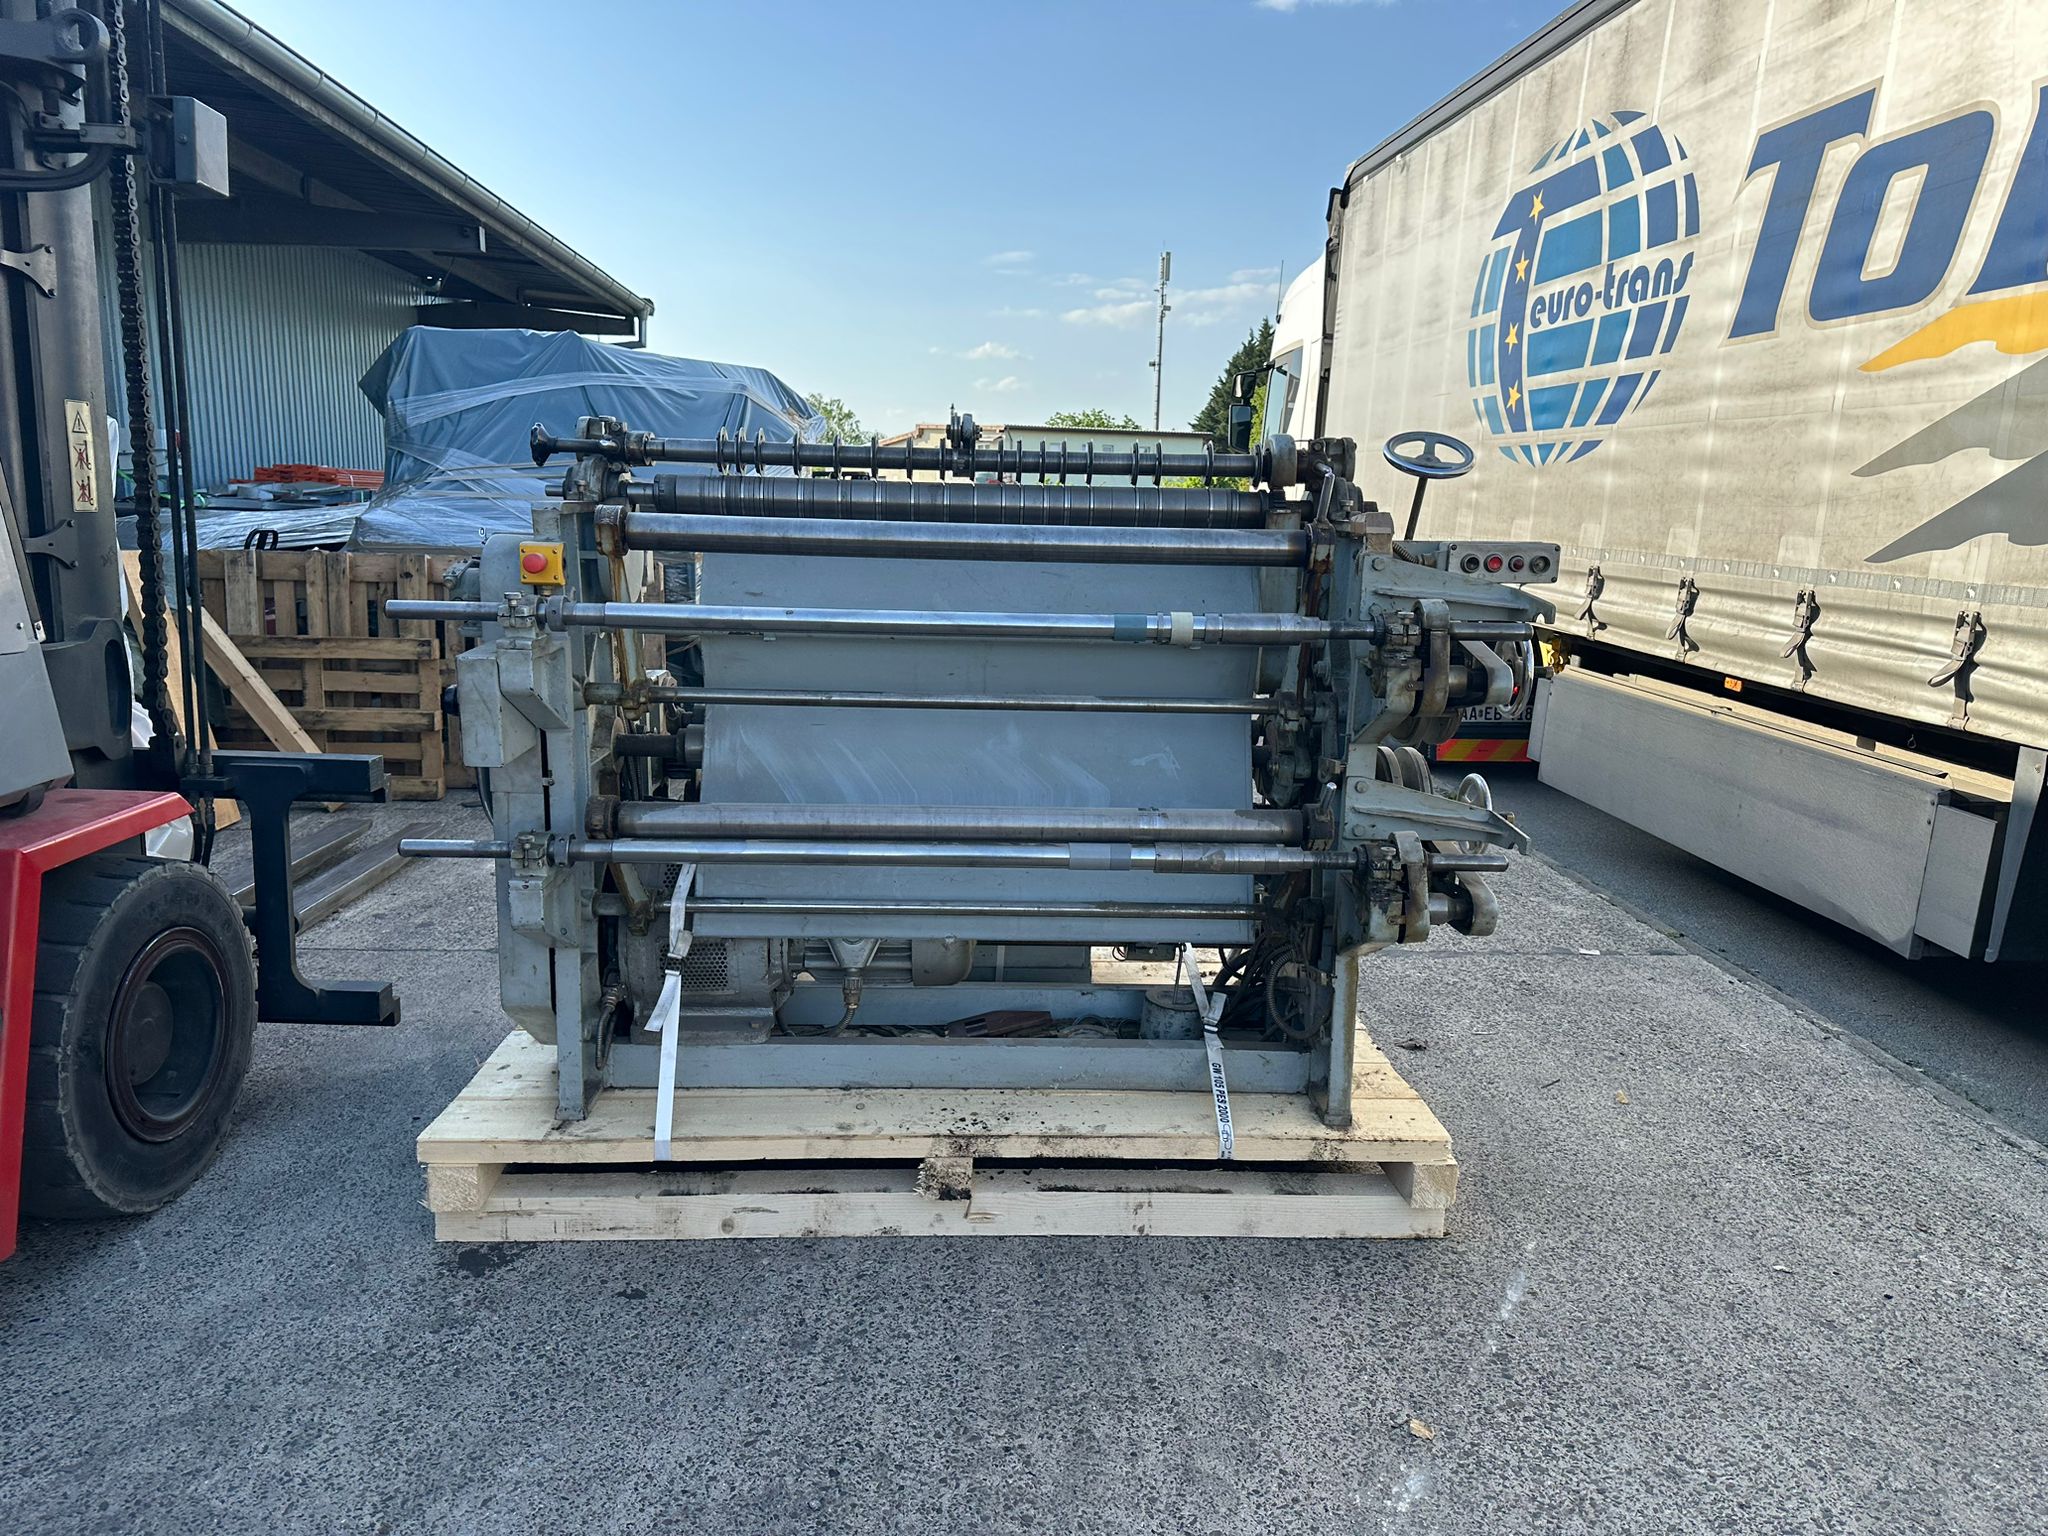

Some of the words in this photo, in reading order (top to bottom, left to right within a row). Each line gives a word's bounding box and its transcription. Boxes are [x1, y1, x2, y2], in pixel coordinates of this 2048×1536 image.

[1529, 250, 1695, 330] euro-trans
[1211, 1062, 1223, 1075] GW
[1213, 1075, 1225, 1089] 105
[1215, 1089, 1227, 1105] PES
[1218, 1105, 1230, 1124] 2000
